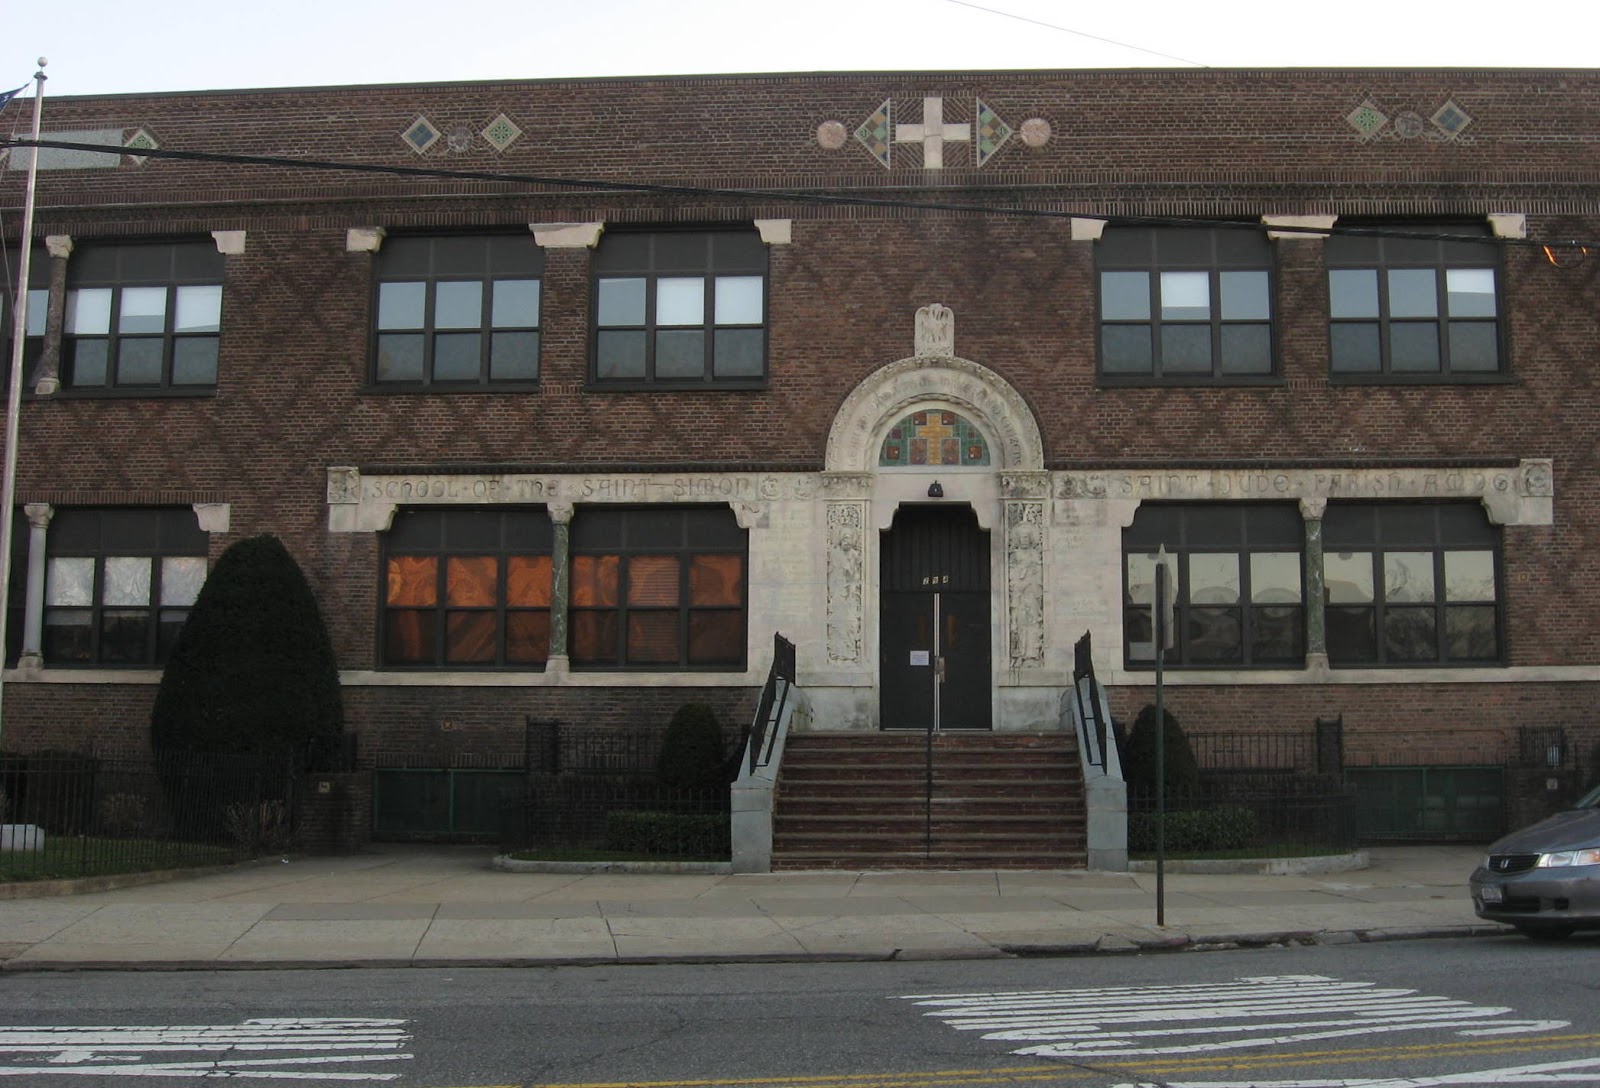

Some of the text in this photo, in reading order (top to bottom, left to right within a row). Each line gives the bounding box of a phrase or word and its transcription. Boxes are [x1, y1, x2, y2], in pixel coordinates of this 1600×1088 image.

[372, 478, 749, 498] SCHOOL OF THE SAINT SIMON
[1121, 474, 1198, 493] SAINT
[1219, 474, 1290, 494] JUDE
[1314, 473, 1401, 496] PARISH
